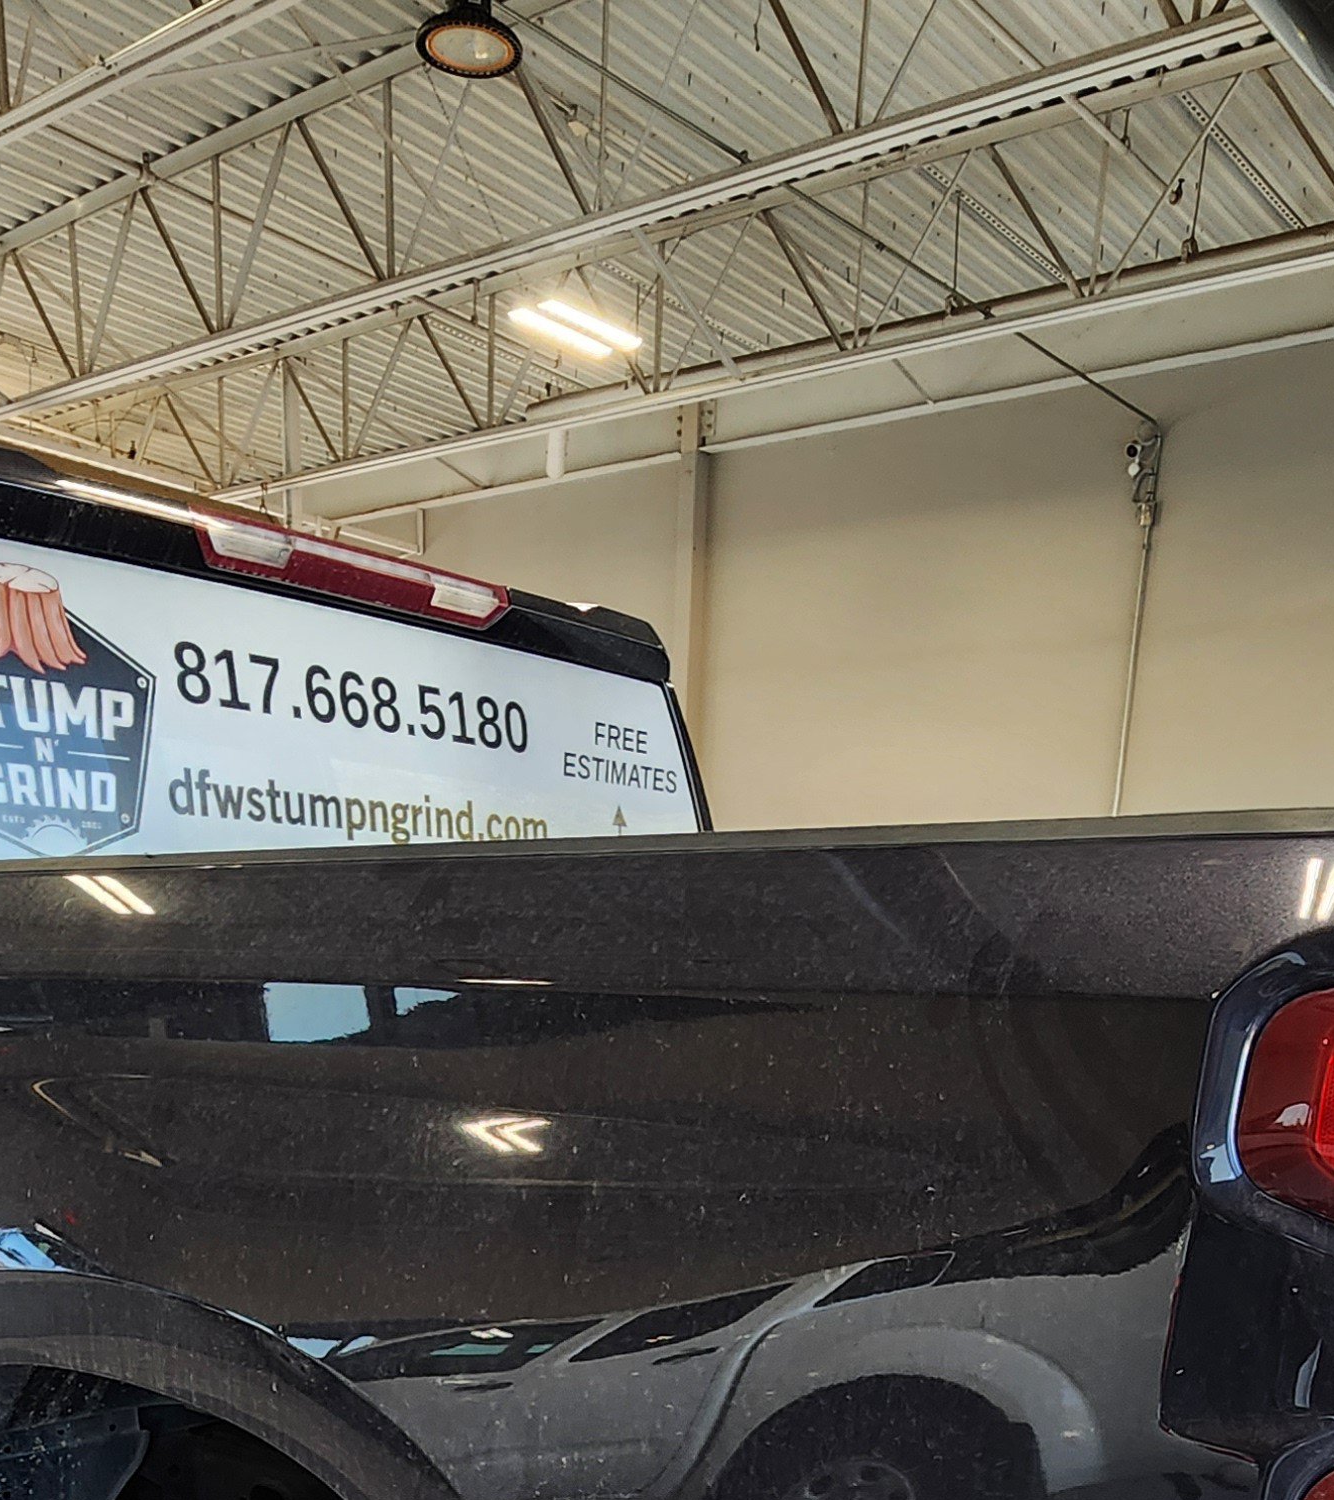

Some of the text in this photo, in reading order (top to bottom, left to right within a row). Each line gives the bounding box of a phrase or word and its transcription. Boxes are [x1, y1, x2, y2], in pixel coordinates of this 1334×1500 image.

[173, 640, 529, 754] 817.668.5180
[593, 720, 649, 755] FREE
[562, 751, 678, 795] ESTIMATES
[167, 767, 548, 846] dfwstumpngrind.com
